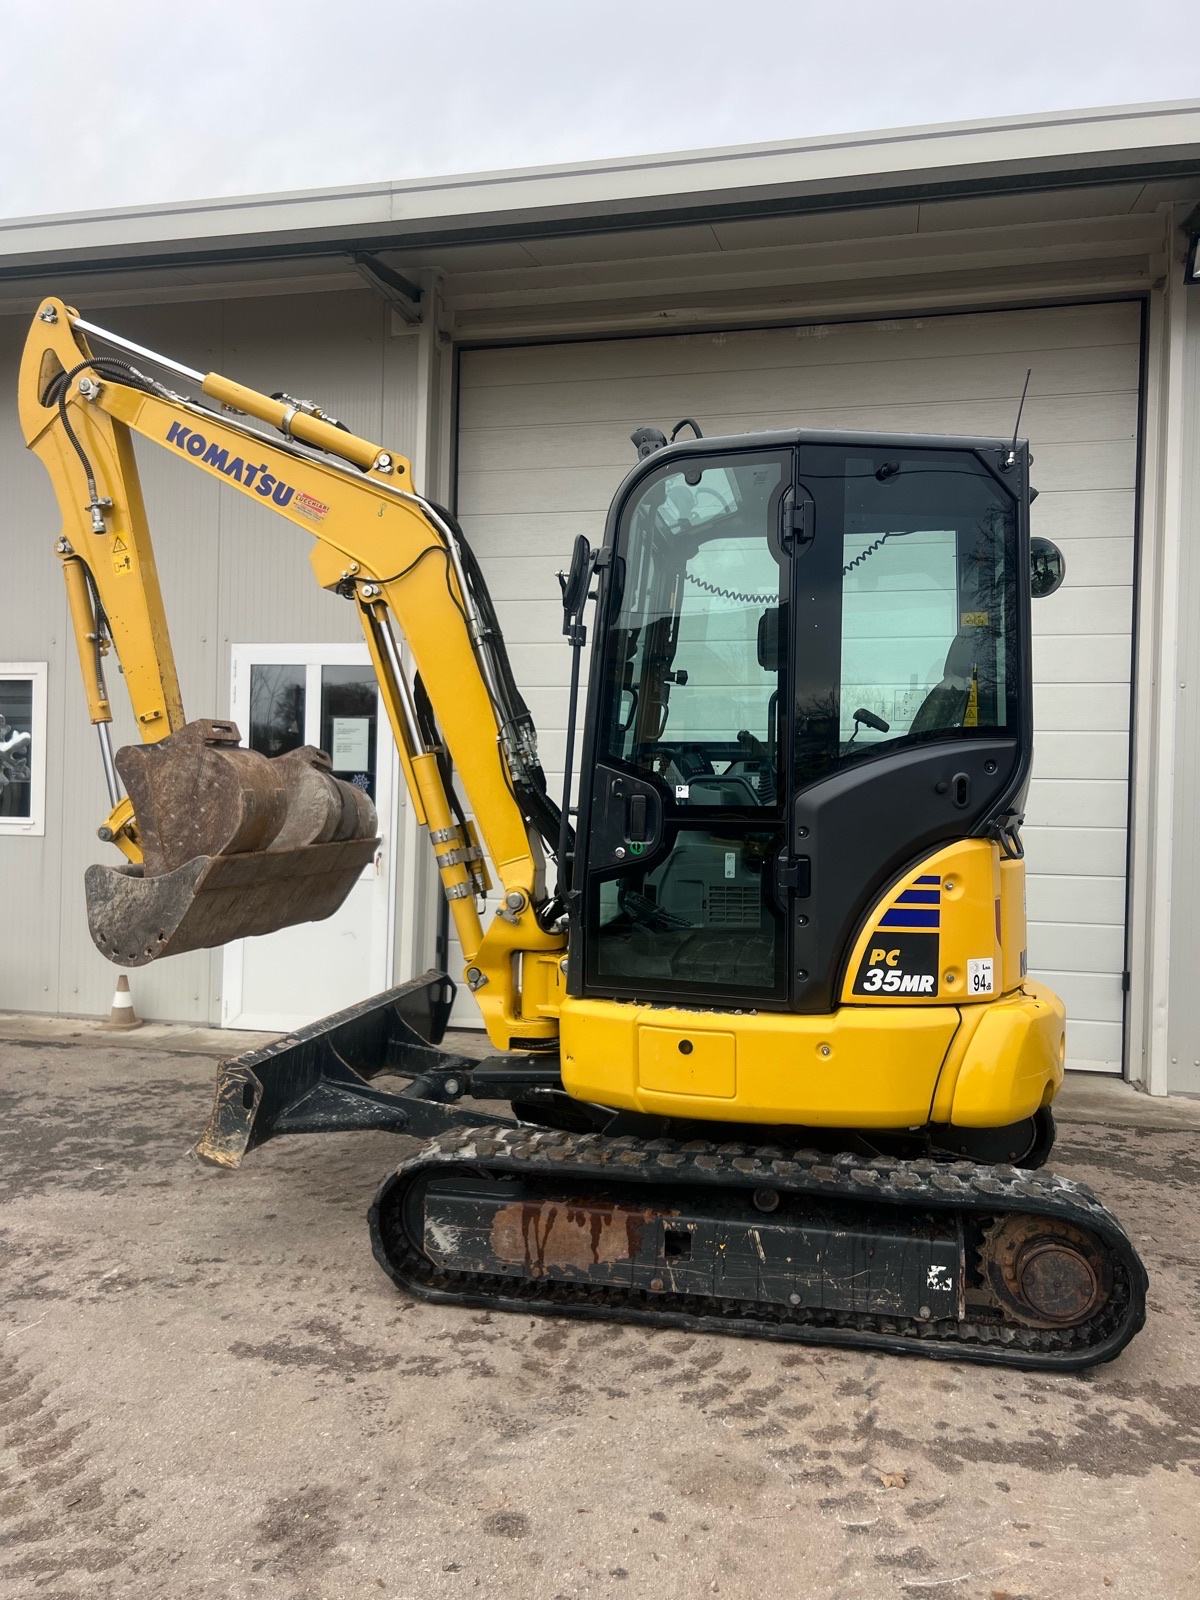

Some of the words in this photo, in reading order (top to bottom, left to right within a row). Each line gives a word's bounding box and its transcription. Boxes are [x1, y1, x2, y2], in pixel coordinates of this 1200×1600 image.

[166, 421, 295, 507] KOMATSU
[868, 948, 900, 966] PC
[863, 968, 935, 992] 35MR
